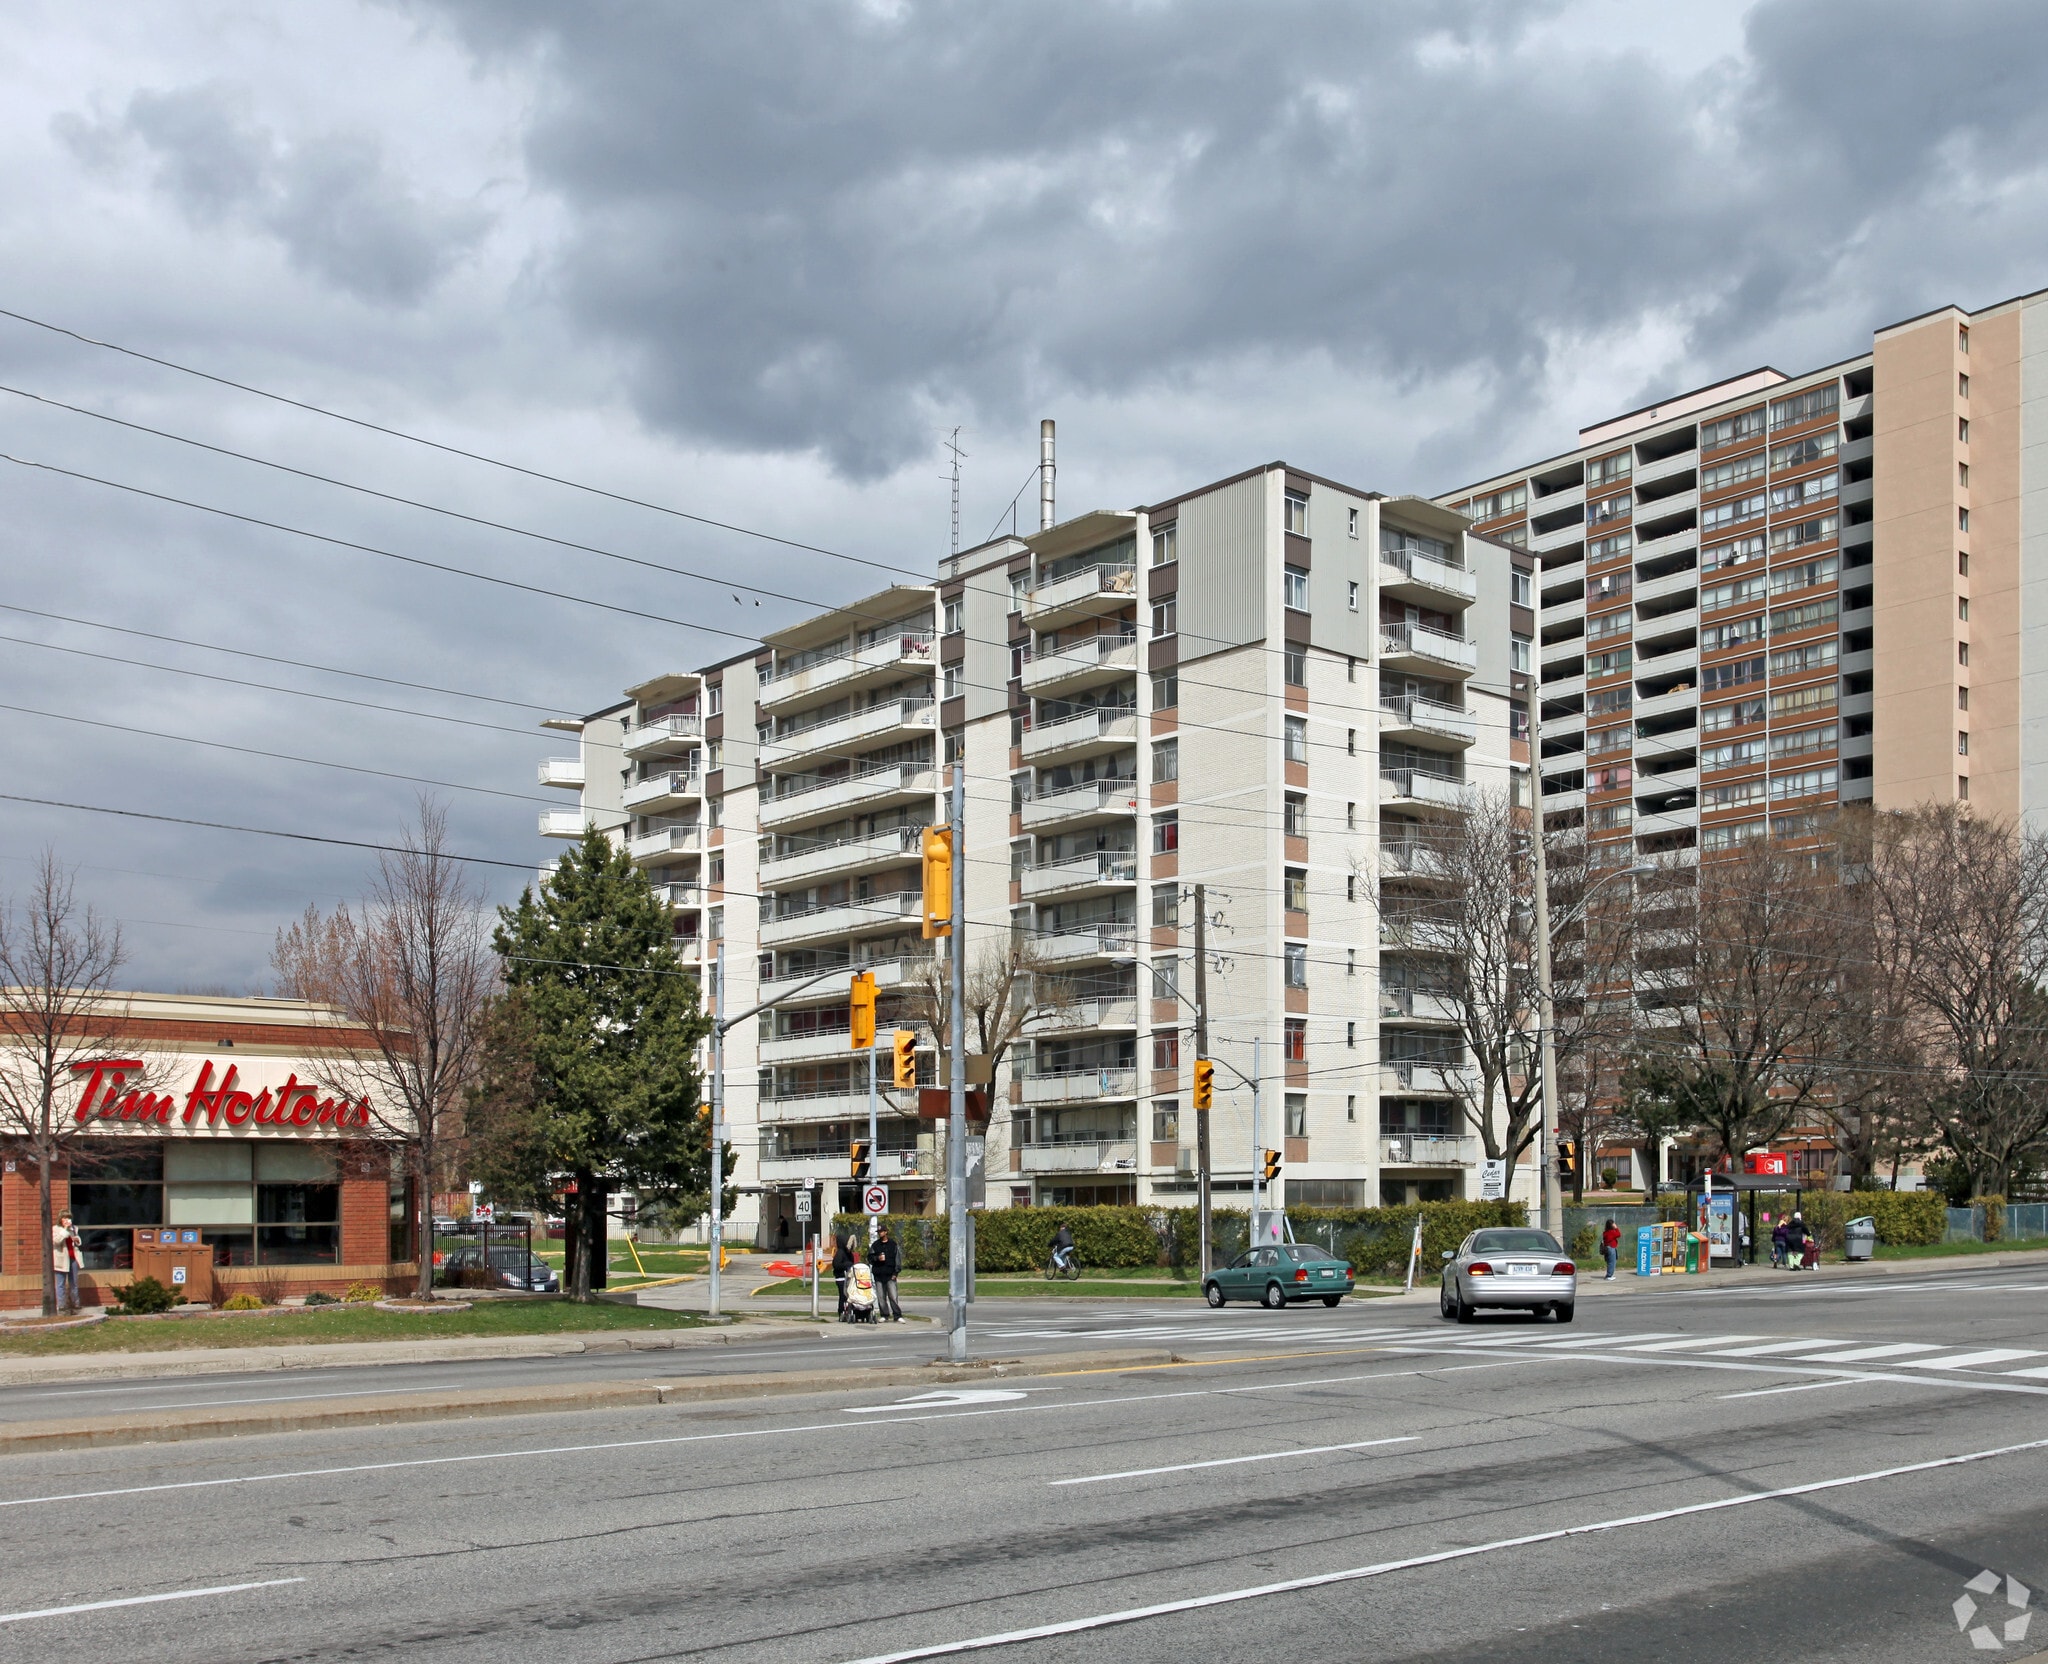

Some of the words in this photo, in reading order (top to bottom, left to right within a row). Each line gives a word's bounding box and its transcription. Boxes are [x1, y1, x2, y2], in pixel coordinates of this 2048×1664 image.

[70, 1060, 174, 1124] Tim
[181, 1059, 370, 1128] Hortons
[798, 1201, 810, 1212] 40
